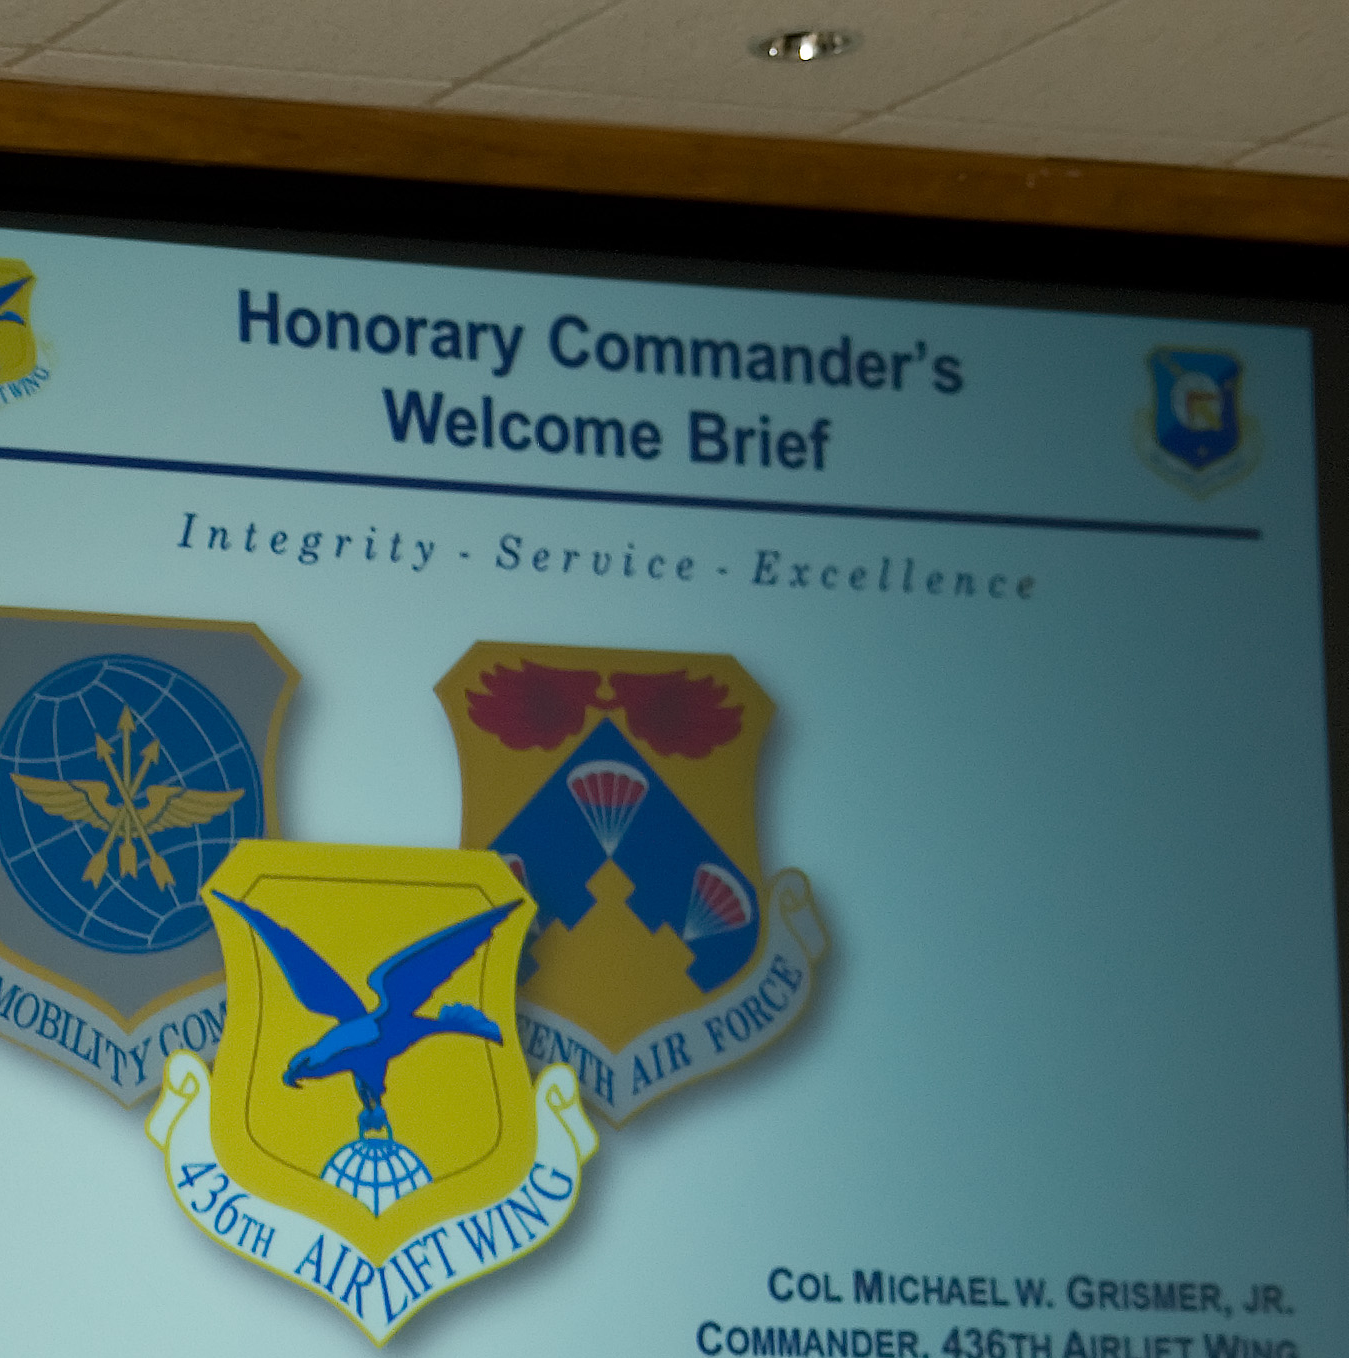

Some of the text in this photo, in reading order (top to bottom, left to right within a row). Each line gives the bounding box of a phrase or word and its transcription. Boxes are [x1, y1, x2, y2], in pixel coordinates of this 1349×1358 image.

[238, 288, 965, 396] Honorary Commander's
[382, 388, 832, 471] Welcome Brief
[178, 512, 435, 572] Integrity
[495, 534, 695, 581] Service
[752, 549, 1038, 601] Excellence
[631, 1031, 693, 1096] AIR
[705, 952, 804, 1055] FORCE
[176, 1158, 576, 1326] 436TH AIRLIFT WING
[1014, 1277, 1054, 1309] W.
[1243, 1284, 1294, 1316] JR.
